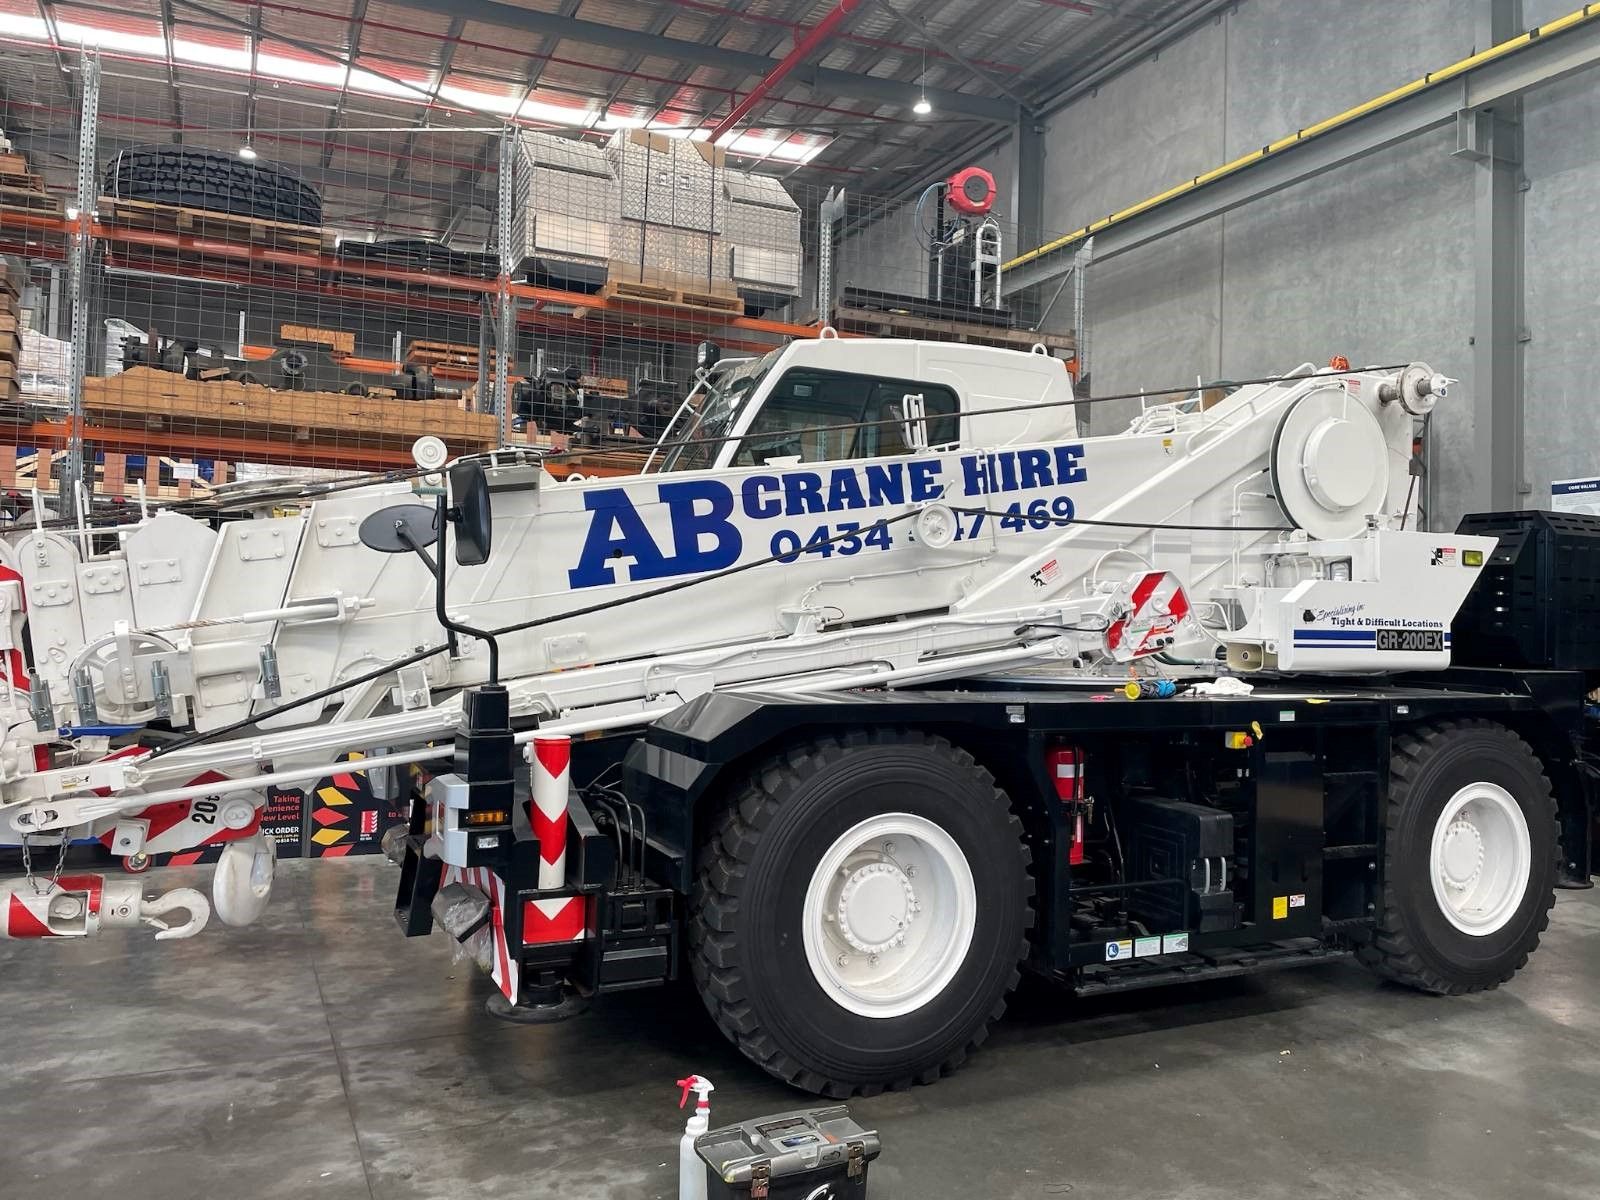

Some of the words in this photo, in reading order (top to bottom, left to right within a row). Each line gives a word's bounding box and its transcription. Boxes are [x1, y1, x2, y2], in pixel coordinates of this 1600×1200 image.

[568, 480, 742, 589] AB
[742, 459, 945, 519] CRANE
[960, 444, 1088, 497] HIRE
[770, 518, 893, 564] 0434
[1000, 495, 1076, 533] 469
[1331, 617, 1355, 627] Tight
[1356, 617, 1364, 626] &
[1365, 617, 1401, 627] Difficult
[1402, 618, 1444, 628] Locations
[1377, 630, 1442, 650] GR-200EX
[273, 795, 300, 803] Taking
[277, 812, 299, 821] Level
[275, 826, 300, 834] ORDER
